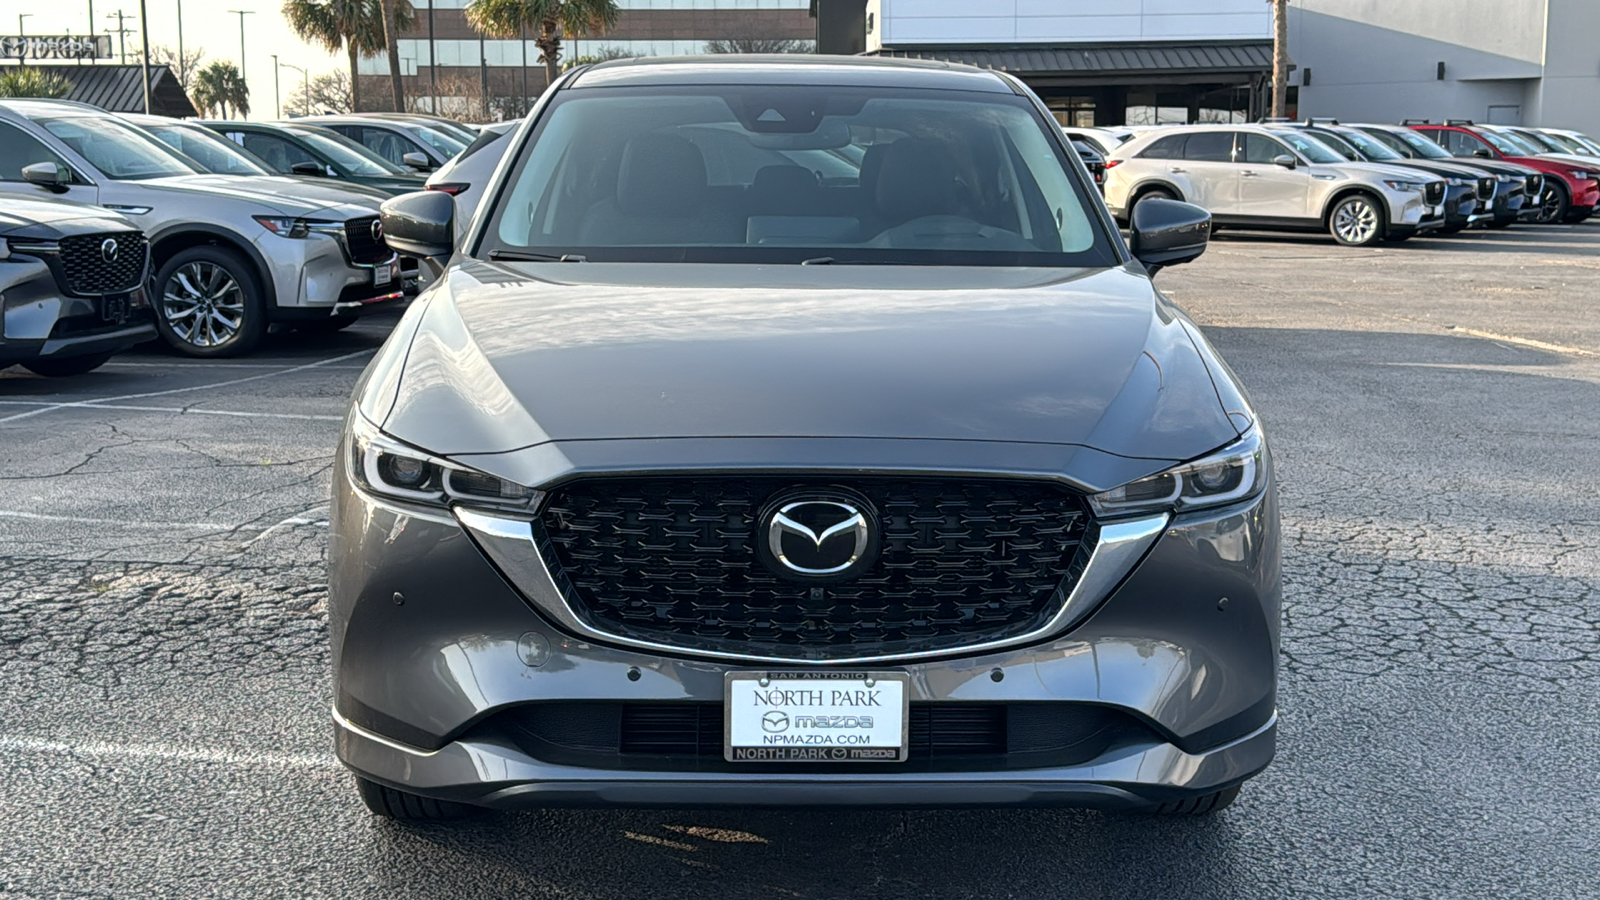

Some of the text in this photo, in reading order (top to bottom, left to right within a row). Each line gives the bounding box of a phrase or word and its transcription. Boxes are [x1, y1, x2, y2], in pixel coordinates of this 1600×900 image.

[753, 689, 882, 707] NORTH PARK
[795, 715, 874, 728] mazda
[763, 734, 871, 744] NPMAZDA.COM
[736, 749, 896, 759] NORTH PARK mazda
